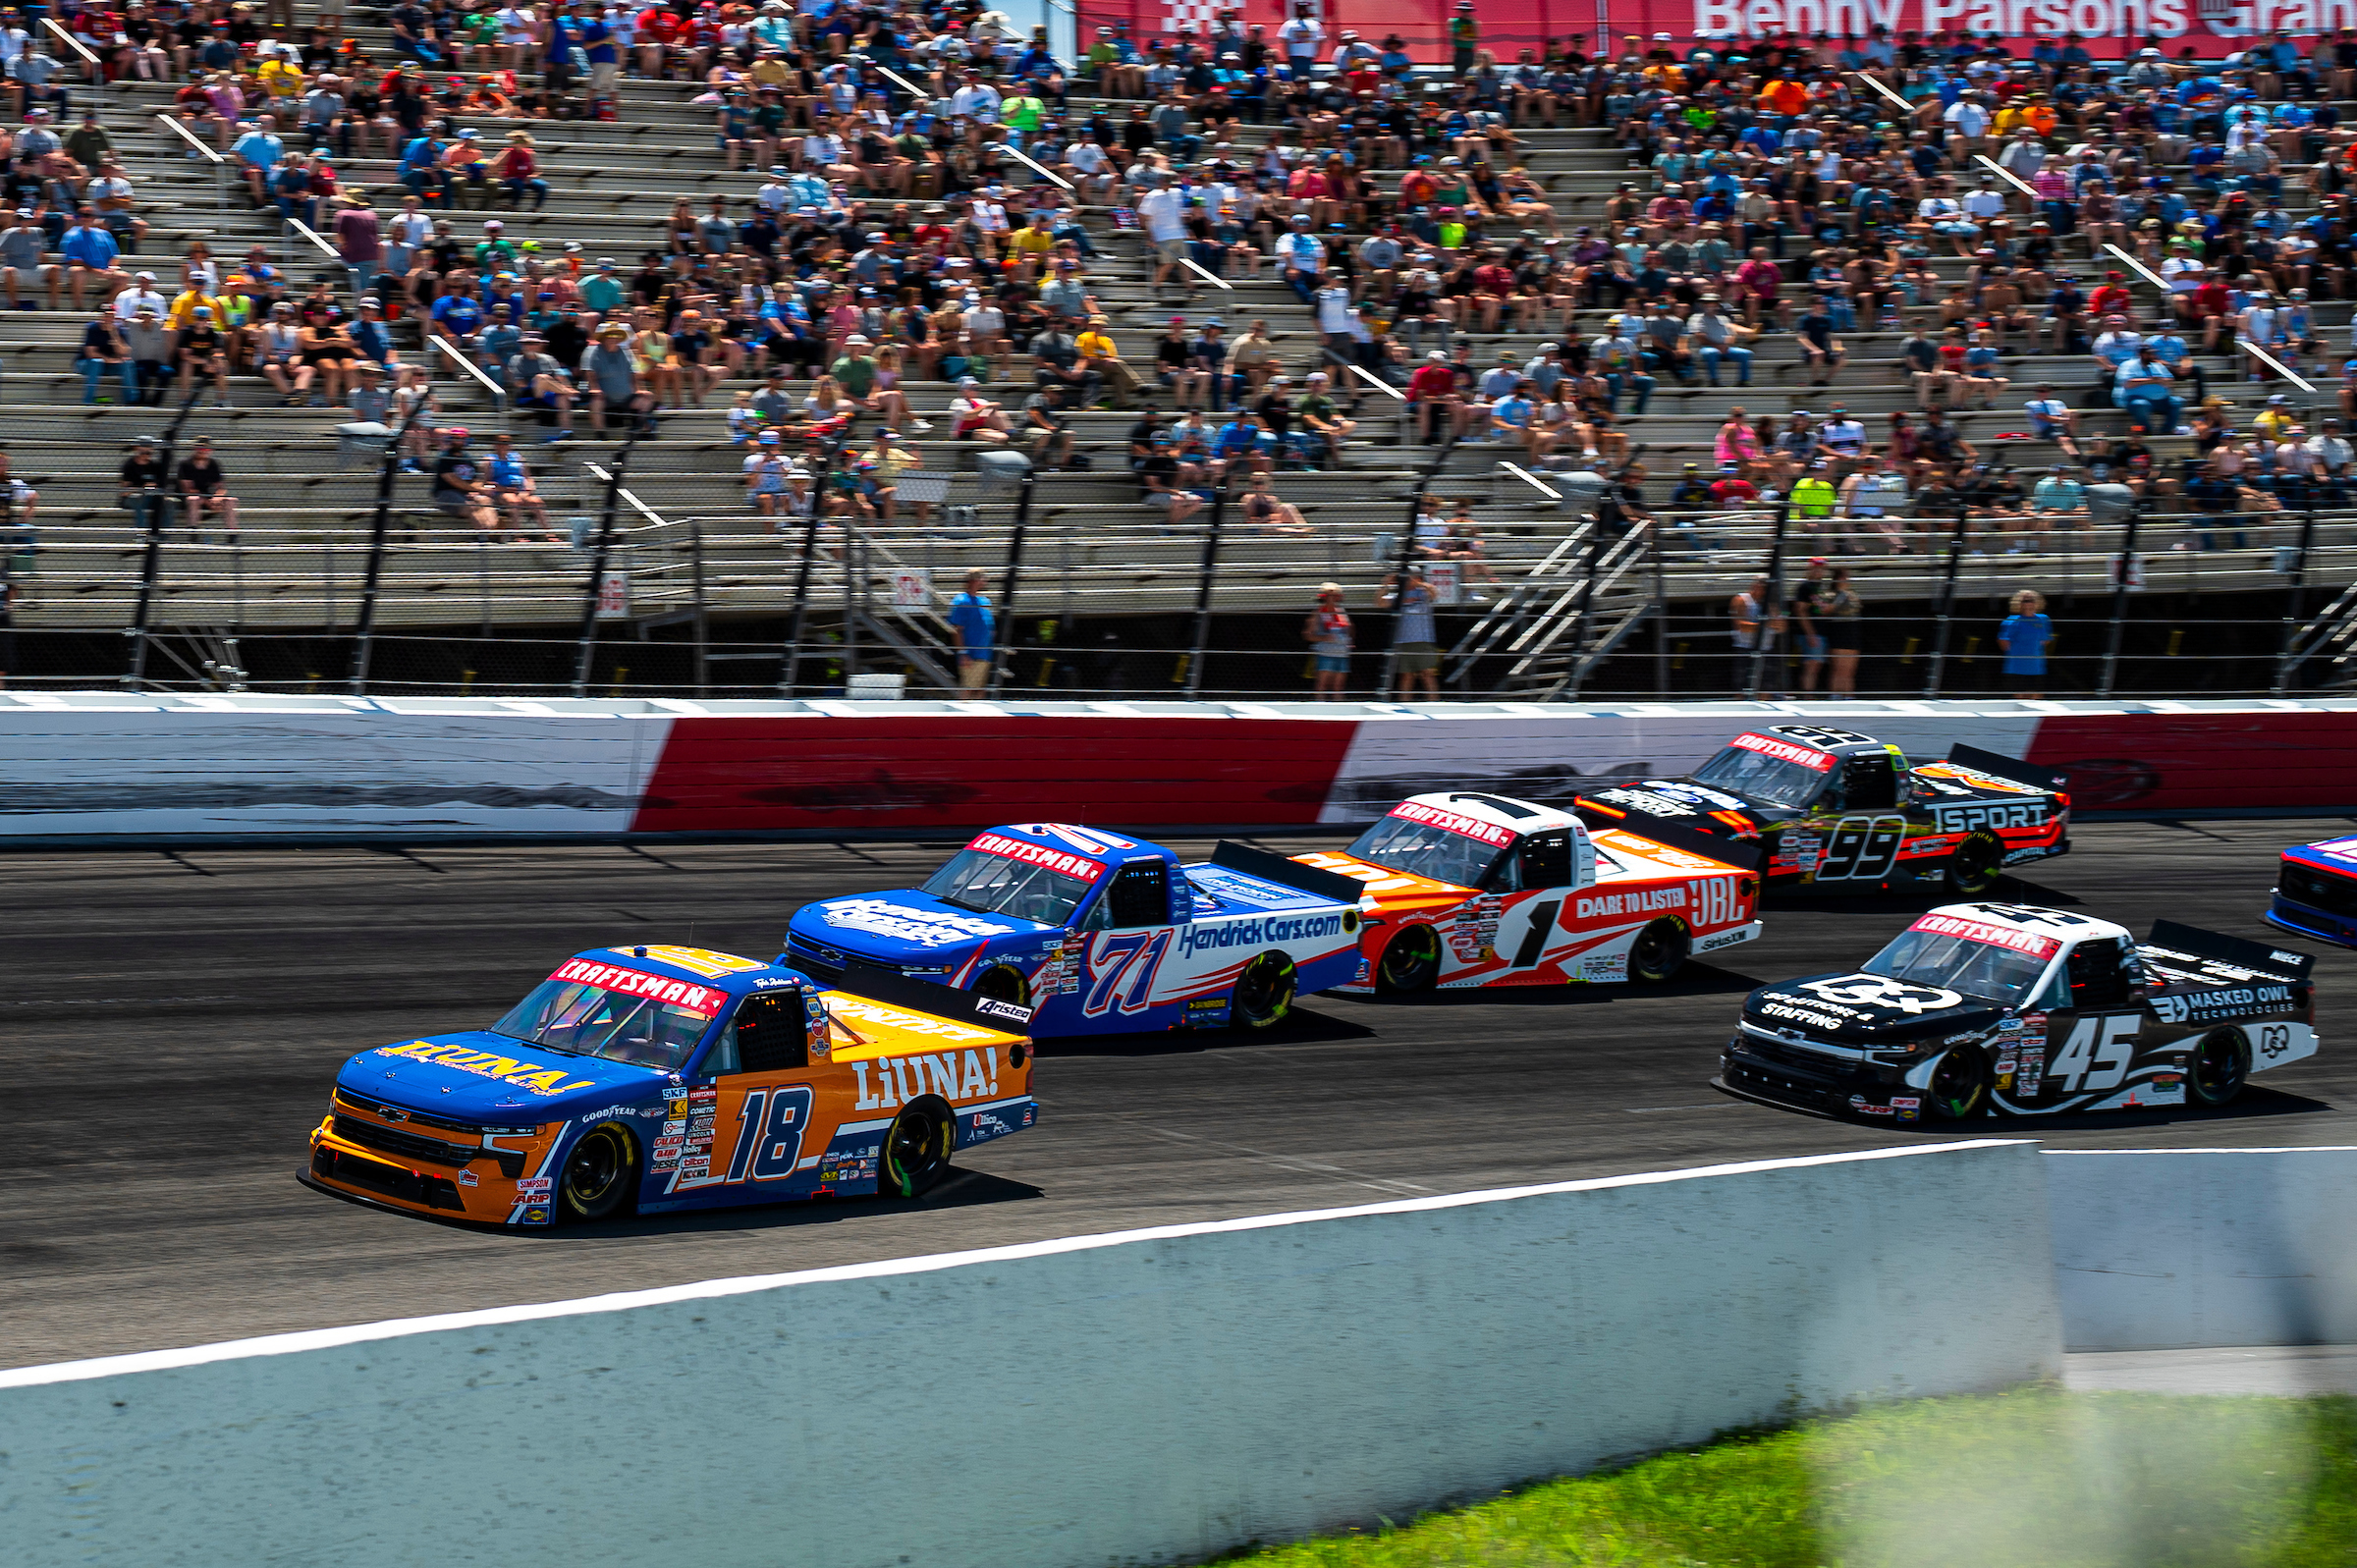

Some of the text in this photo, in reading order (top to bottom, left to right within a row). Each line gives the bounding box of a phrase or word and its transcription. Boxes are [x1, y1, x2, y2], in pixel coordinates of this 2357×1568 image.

[1693, 0, 1903, 38] Benny
[1957, 0, 2192, 38] Parsons
[1733, 734, 1827, 768] CRAFTSMAN
[1395, 802, 1502, 843] CRAFTSMAN
[973, 834, 1093, 877] CRAFTSMAN
[1815, 814, 1907, 881] 99
[1576, 887, 1686, 919] DARE TO LISTEN
[1510, 899, 1562, 967] 1
[1917, 915, 2048, 954] CRAFTSMAN
[558, 961, 708, 1008] CRAFTSMAN
[1082, 928, 1176, 1019] 71
[978, 1000, 1030, 1019] Aristeo
[1763, 992, 1860, 1018] SOLUTIONS
[2187, 985, 2294, 1008] MASKED OWL
[2191, 1002, 2294, 1021] TECHNOLOGIES
[1761, 1002, 1843, 1030] STAFFING
[382, 1041, 596, 1094] LiUNA!
[2047, 1012, 2144, 1095] 45
[663, 1088, 685, 1099] SKF
[851, 1047, 999, 1111] LiUNA!
[581, 1105, 636, 1124] GOODYEAR
[723, 1083, 816, 1186] 18
[513, 1194, 550, 1204] ARP
[520, 1178, 550, 1189] SIMPSON
